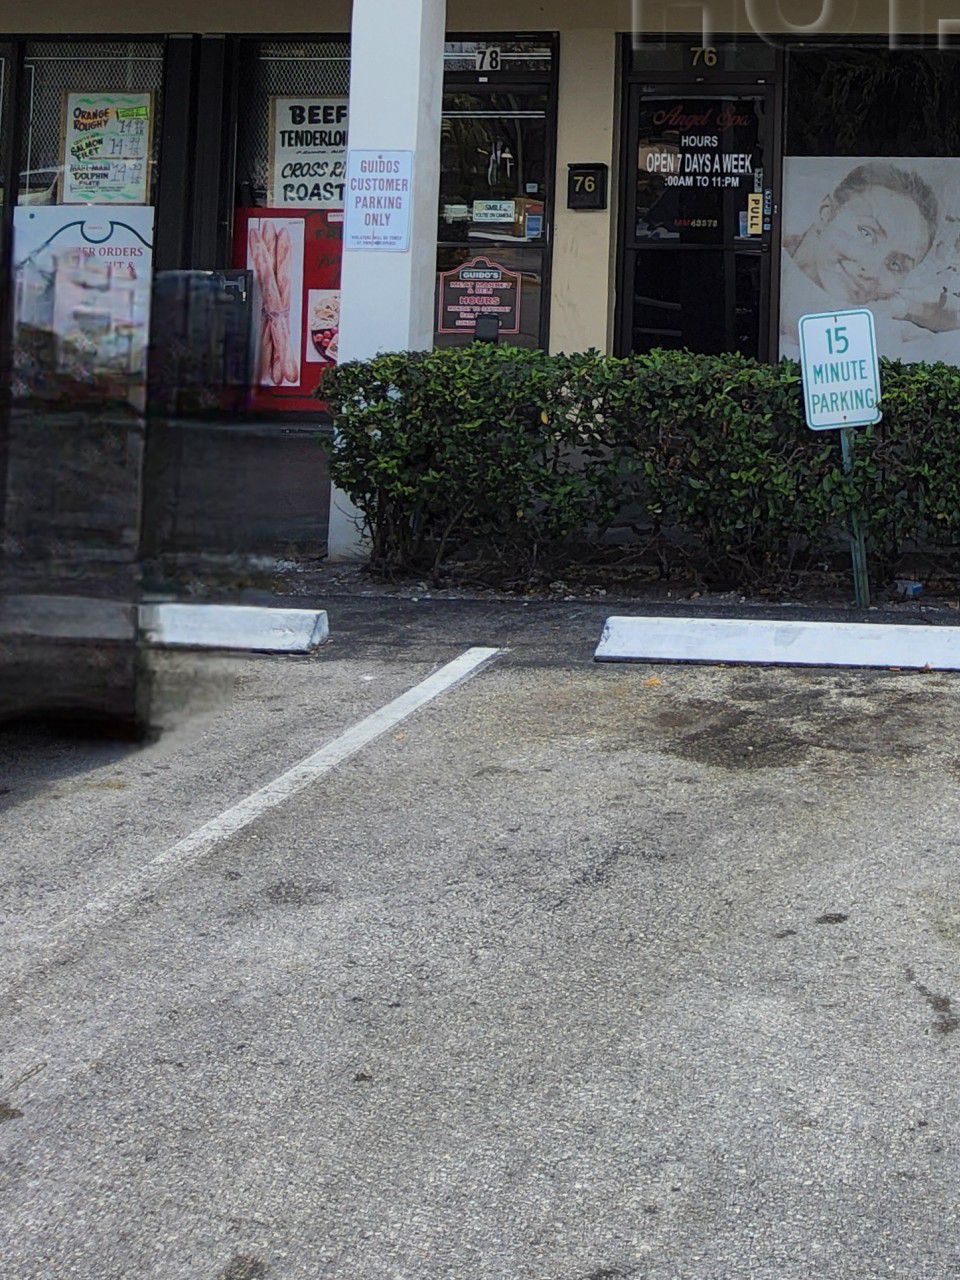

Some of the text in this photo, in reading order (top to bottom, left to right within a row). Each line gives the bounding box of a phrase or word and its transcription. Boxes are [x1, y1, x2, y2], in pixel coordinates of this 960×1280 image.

[477, 50, 499, 69] 78
[690, 47, 717, 66] 76
[73, 107, 110, 120] ORANGE
[289, 105, 347, 125] BEEF
[73, 119, 109, 131] ROUGHY
[681, 136, 718, 147] HOURS
[281, 161, 328, 179] CROSS
[360, 160, 400, 173] GUIDOS
[647, 153, 752, 173] OPEN 7 DAYS A WEEK
[73, 172, 109, 180] DOLPHIN
[696, 176, 709, 187] TO
[711, 176, 739, 187] 11:PM
[283, 182, 346, 201] ROAST
[350, 177, 408, 192] CUSTOMER
[573, 176, 595, 192] 76
[355, 196, 402, 209] PARKING
[364, 213, 391, 226] ONLY
[750, 198, 759, 229] PULL
[99, 247, 143, 257] ORDERS
[459, 296, 500, 305] HOURS
[825, 326, 849, 354] 15
[813, 360, 868, 385] MINUTE
[812, 388, 874, 414] PARKING
